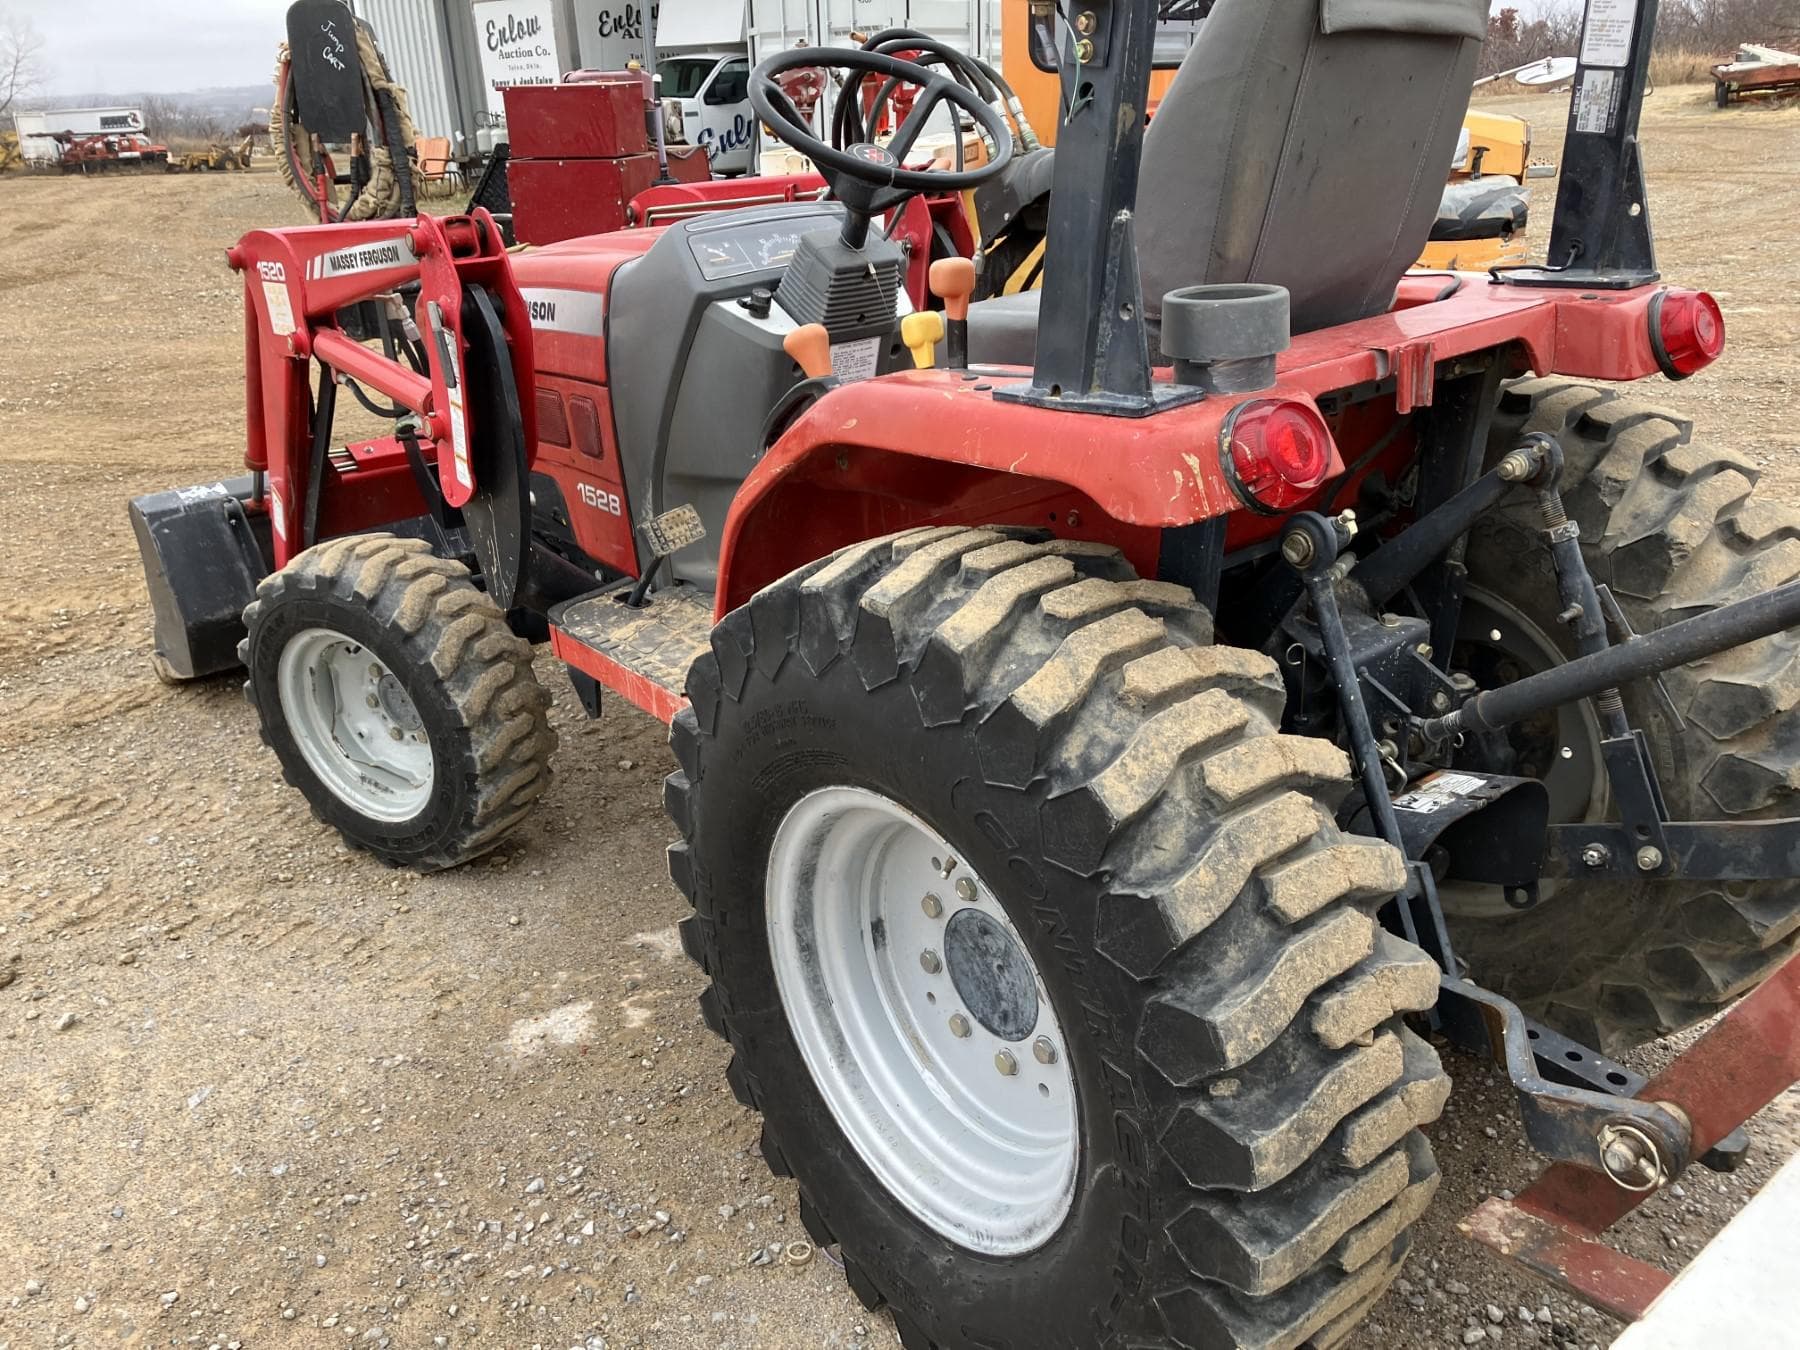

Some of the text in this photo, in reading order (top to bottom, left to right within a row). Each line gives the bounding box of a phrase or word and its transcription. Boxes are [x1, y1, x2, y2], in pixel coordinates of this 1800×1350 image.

[320, 19, 345, 53] Jump
[486, 14, 542, 52] Enlow
[498, 44, 551, 60] Auction Co.
[256, 260, 287, 282] 1520
[329, 245, 401, 272] MASSEY FERGUSON
[576, 482, 622, 517] 1528
